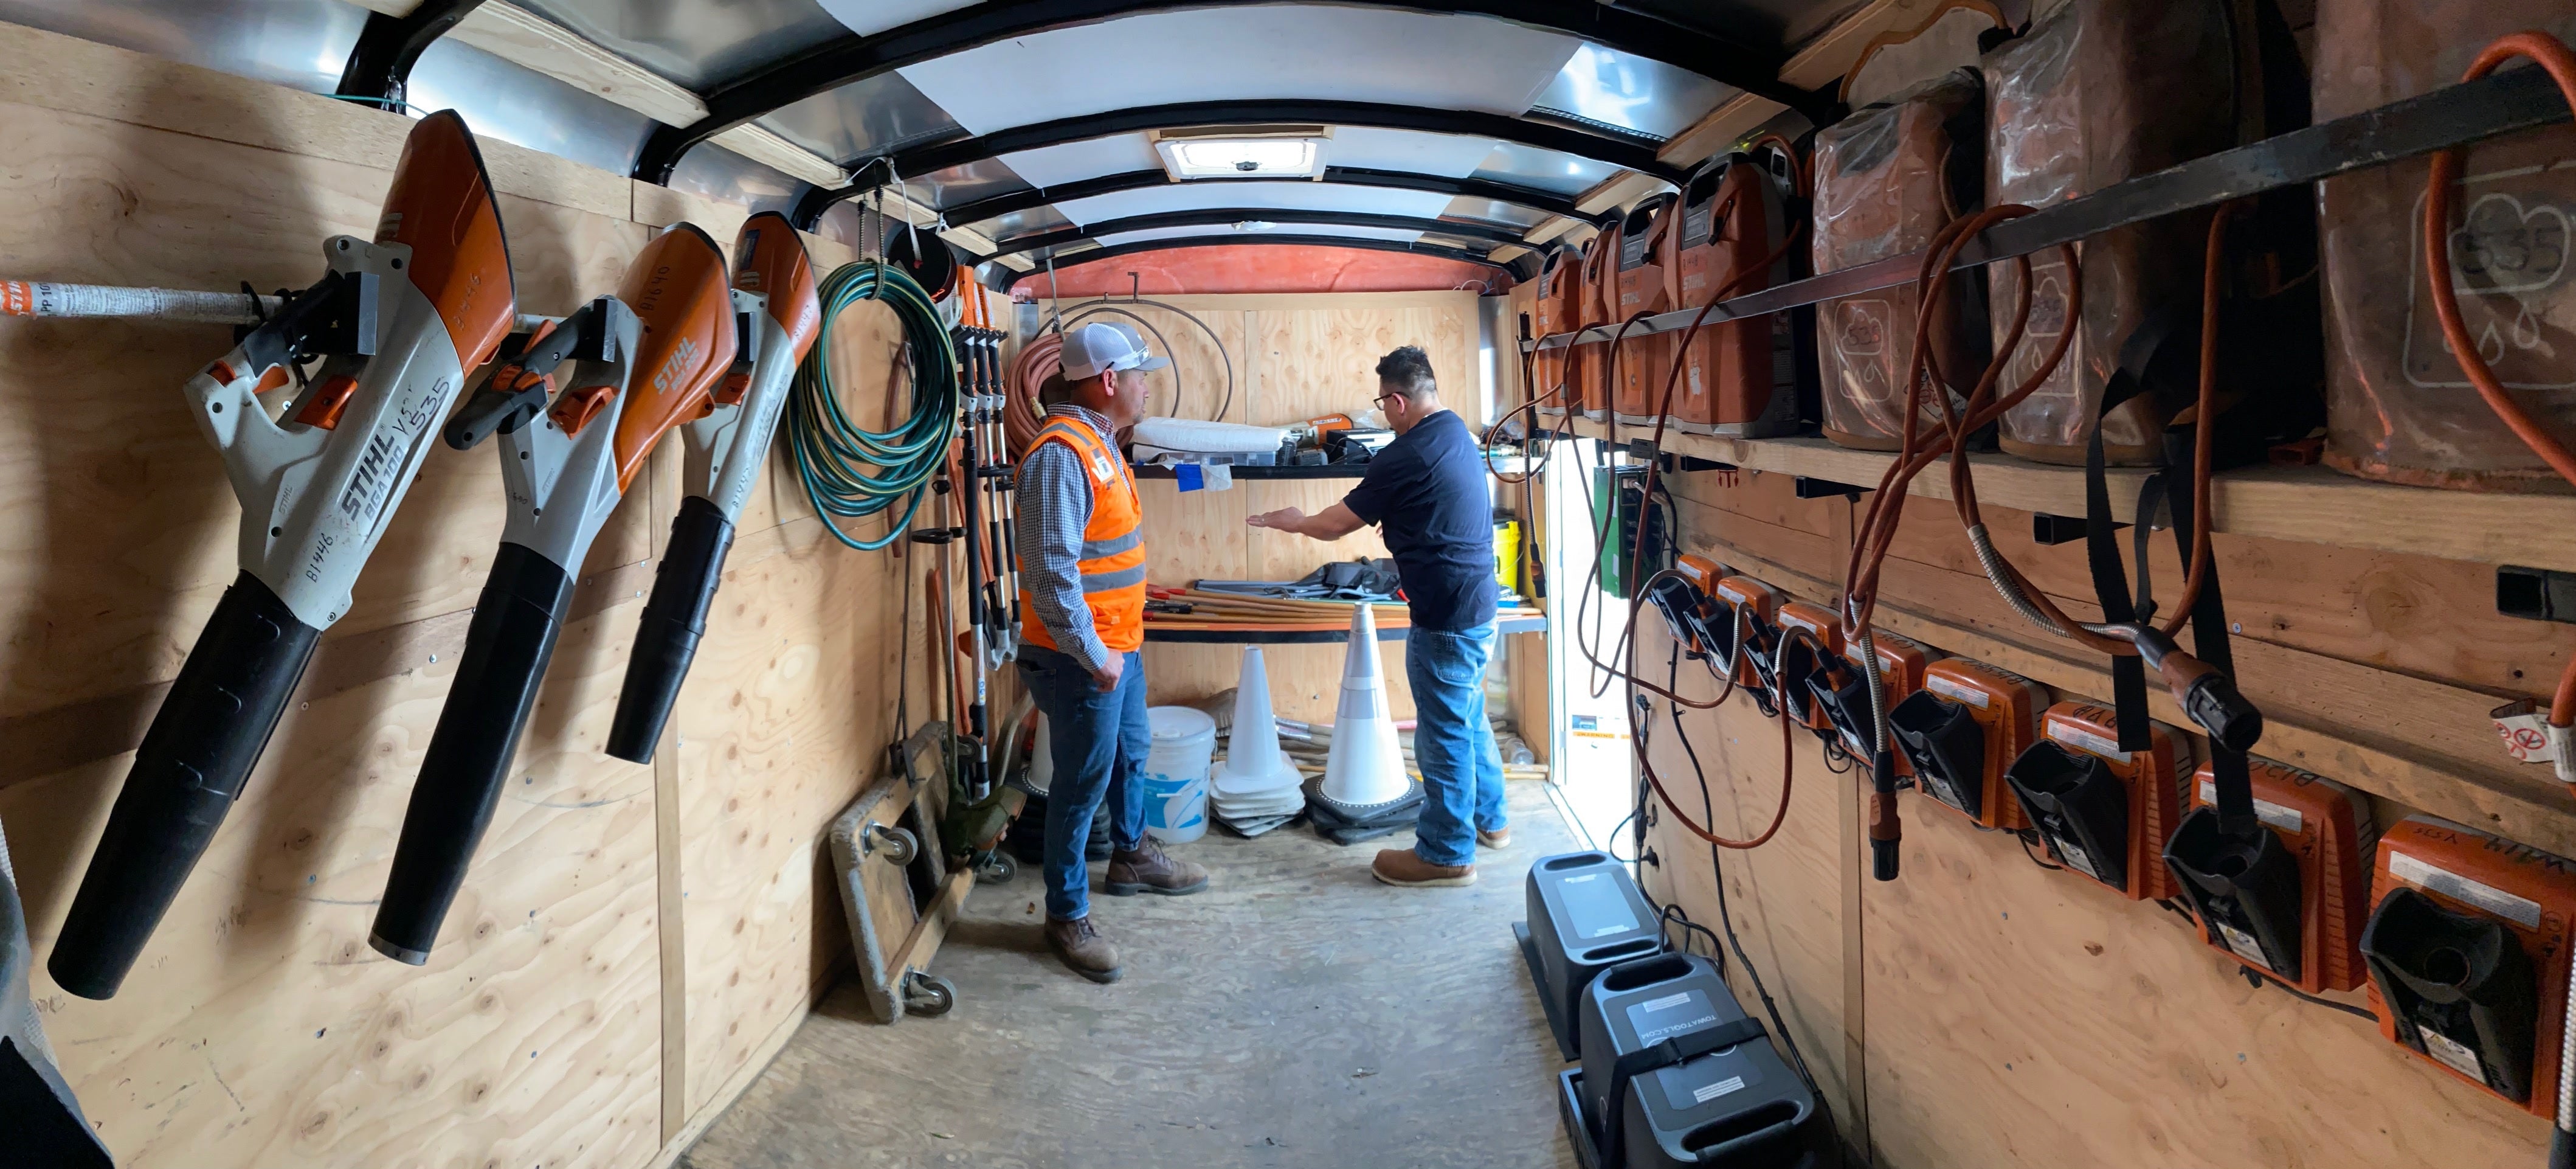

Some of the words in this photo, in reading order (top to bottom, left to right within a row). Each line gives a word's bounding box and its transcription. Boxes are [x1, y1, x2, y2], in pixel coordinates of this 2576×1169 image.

[2463, 225, 2563, 274] 535
[1621, 291, 1641, 305] STIHL
[1683, 272, 1707, 291] STIHL
[652, 336, 697, 395] STIHL
[409, 376, 451, 431] 535
[278, 484, 294, 515] STIHL
[341, 433, 395, 522] STIHL
[364, 480, 387, 522] BGA
[383, 445, 406, 482] 100
[305, 533, 334, 583] B1446
[1641, 1014, 1718, 1039] TOWATOOLS.COM
